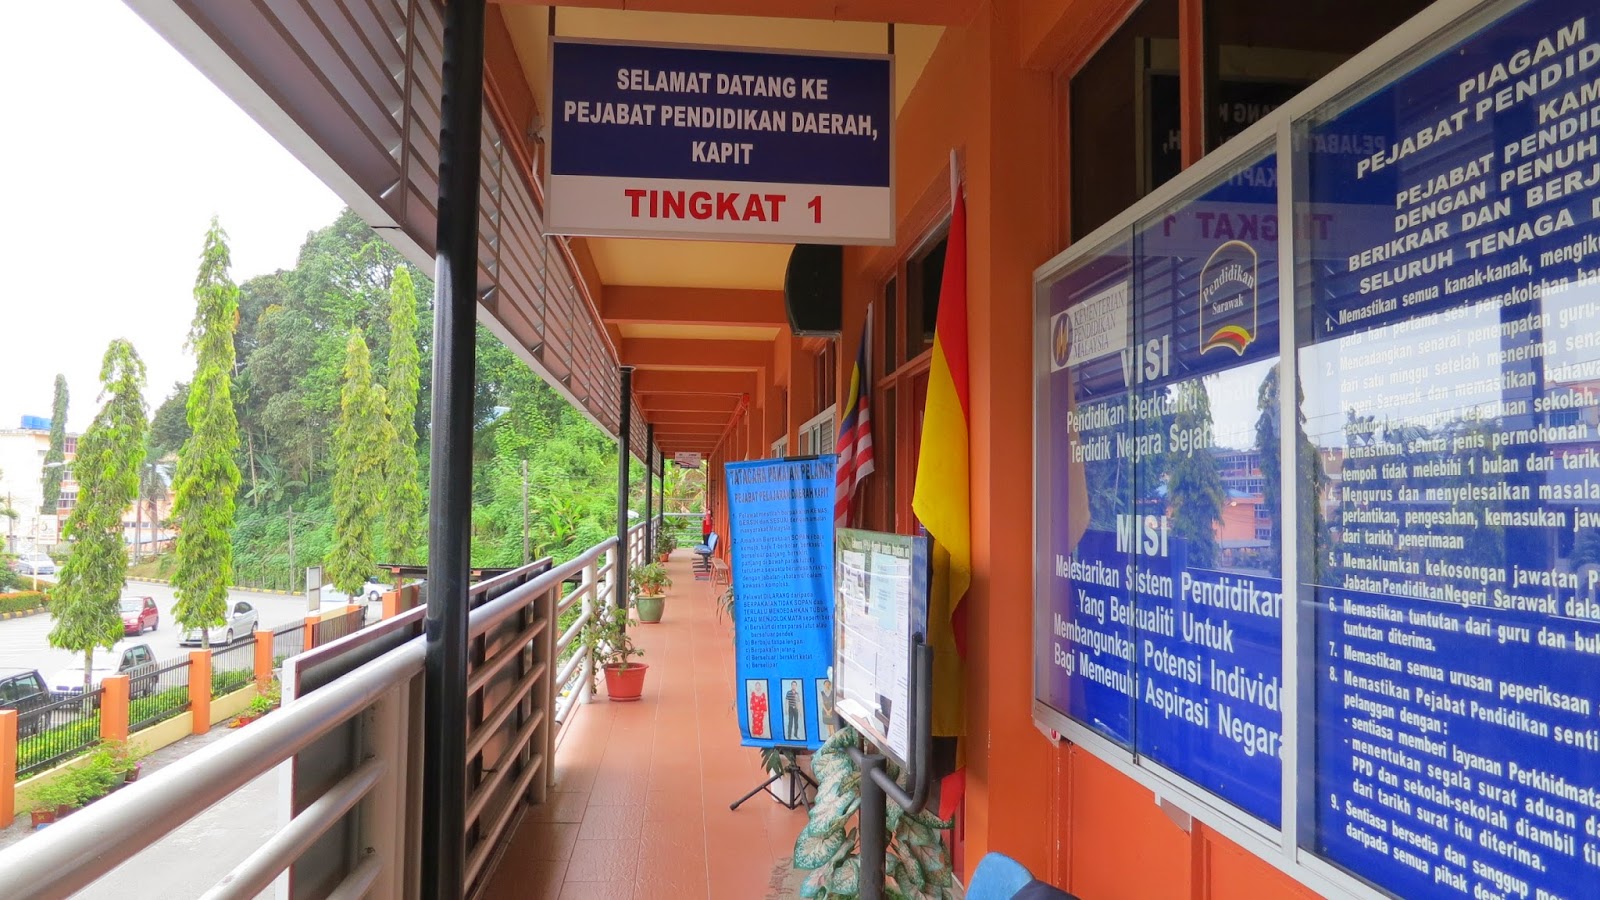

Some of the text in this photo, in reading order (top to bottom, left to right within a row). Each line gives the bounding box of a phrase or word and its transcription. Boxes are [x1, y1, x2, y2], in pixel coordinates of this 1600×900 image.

[1459, 17, 1586, 103] PIAGAM
[617, 68, 828, 100] SELAMAT DATANG KE
[564, 100, 878, 141] PEJABAT PENDIDIKAN DAERAH,
[692, 141, 753, 165] KAPIT
[1357, 108, 1468, 180] PEJABAT
[1395, 136, 1598, 233] DENGAN PENUH
[1396, 153, 1494, 210] PEJABAT
[624, 189, 822, 224] TINGKAT 1
[1349, 222, 1449, 272] BERIKRAR
[1461, 197, 1510, 232] DAN
[1359, 209, 1575, 295] SELURUH TENAGA
[1202, 264, 1256, 303] Pendidikan
[1339, 298, 1397, 326] Memastikan
[1402, 284, 1439, 307] semua
[1444, 255, 1532, 295] kanak-kanak,
[1444, 300, 1469, 321] sesi
[1475, 275, 1568, 313] persekolahan
[1074, 288, 1126, 325] KEMENTERIAN
[1212, 294, 1244, 315] Sarawak
[1074, 312, 1117, 343] PENDIDIKAN
[1074, 335, 1110, 360] MALAYSIA
[1467, 311, 1550, 345] penempatan
[1121, 335, 1169, 387] VISI
[1434, 352, 1479, 376] setelah
[1487, 339, 1557, 367] menerima
[1455, 370, 1535, 394] memastikan
[1534, 390, 1598, 413] sekolah.
[1067, 402, 1124, 434] Pendidikan
[1408, 434, 1447, 453] semua
[1453, 431, 1484, 454] jenis
[1492, 422, 1587, 448] permohonan
[1070, 429, 1162, 464] Terdidik Negara
[730, 468, 767, 485] TATACARA
[801, 462, 833, 480] PELAWAT
[1342, 464, 1377, 482] tempoh
[1382, 463, 1408, 479] tidak
[1413, 458, 1461, 478] melebihi
[1468, 460, 1474, 475] 1
[1482, 455, 1518, 474] bulan
[1526, 452, 1554, 472] dari
[1342, 486, 1392, 505] Mengurus
[1398, 485, 1419, 501] dan
[1426, 482, 1530, 505] menyelesaikan
[1116, 514, 1168, 557] MISI
[1342, 508, 1400, 526] perlantikan,
[1405, 508, 1479, 529] pengesahan,
[1485, 507, 1566, 527] kemasukan
[1342, 529, 1464, 550] dari tarikh penerimaan
[1056, 554, 1120, 589] Melestarikan
[1125, 566, 1173, 599] Sistem
[1328, 552, 1578, 589] 5. Memaklumkan kekosongan jawatan
[1078, 589, 1234, 653] Yang Berkualiti Untuk
[1493, 589, 1557, 615] Sarawak
[1328, 597, 1566, 649] 6. Memastikan tuntutan dari guru dan
[1343, 620, 1436, 651] tuntutan diterima.
[1054, 613, 1282, 713] Membangunkan Potensi Individ
[1329, 642, 1590, 715] 7. Memastikan semua urusan peperiksaan
[1054, 643, 1209, 729] Bagi Memenuhi Aspirasi
[1329, 666, 1338, 682] 8.
[1344, 669, 1410, 702] Memastikan
[1416, 687, 1466, 718] Pejabat
[1470, 701, 1549, 738] Pendidikan
[1344, 693, 1395, 719] pelanggan
[1351, 714, 1394, 741] sentiasa
[1398, 730, 1447, 759] memberi
[1453, 744, 1502, 777] layanan
[1352, 738, 1576, 829] menentukan segala surat aduan
[1352, 756, 1373, 778] PPD
[1378, 767, 1398, 788] dan
[1403, 777, 1508, 830] sekolah-sekolah
[1515, 818, 1575, 857] diambil
[1353, 778, 1546, 873] dari tarikh surat itu diterima.
[1330, 793, 1339, 811] 9.
[1345, 800, 1387, 832] Sentiasa
[1392, 823, 1438, 856] bersedia
[1444, 844, 1466, 869] dan
[1472, 858, 1529, 900] sanggup
[1346, 823, 1388, 855] daripada
[1393, 848, 1429, 875] semua
[1434, 864, 1468, 894] pihak
